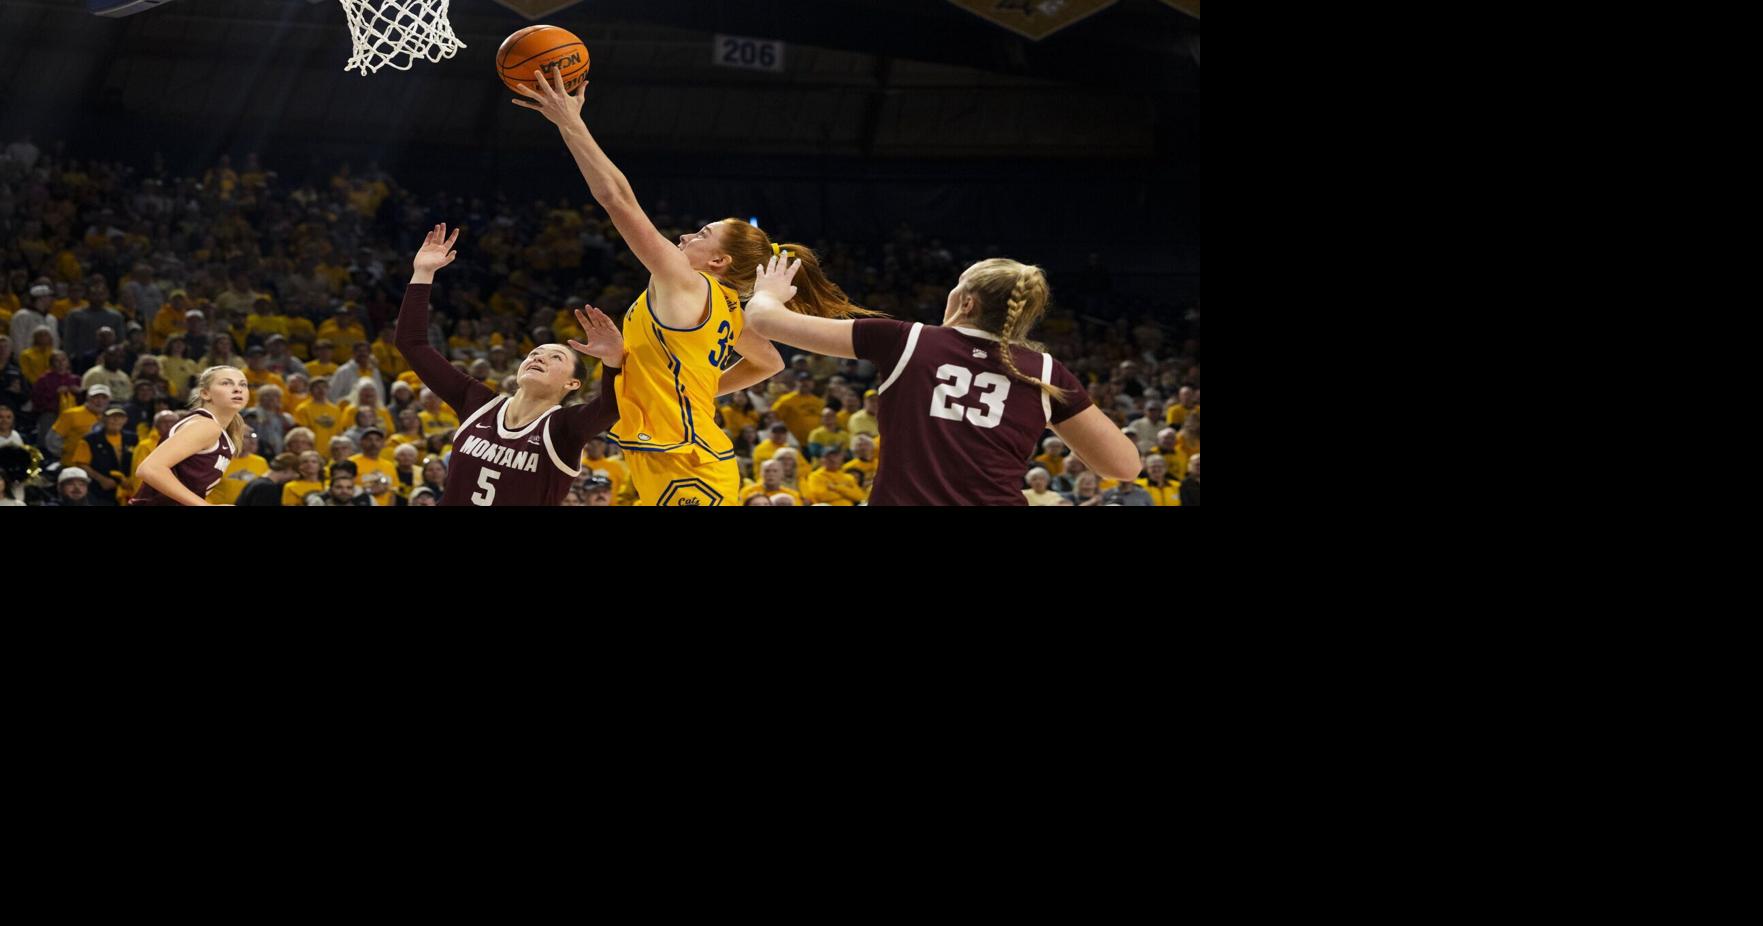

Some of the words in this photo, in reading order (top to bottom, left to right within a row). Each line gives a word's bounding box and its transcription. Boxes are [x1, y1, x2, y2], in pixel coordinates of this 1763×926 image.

[724, 40, 775, 66] 206
[930, 363, 1011, 429] 23
[459, 435, 540, 473] MONTANA
[471, 466, 501, 506] 5
